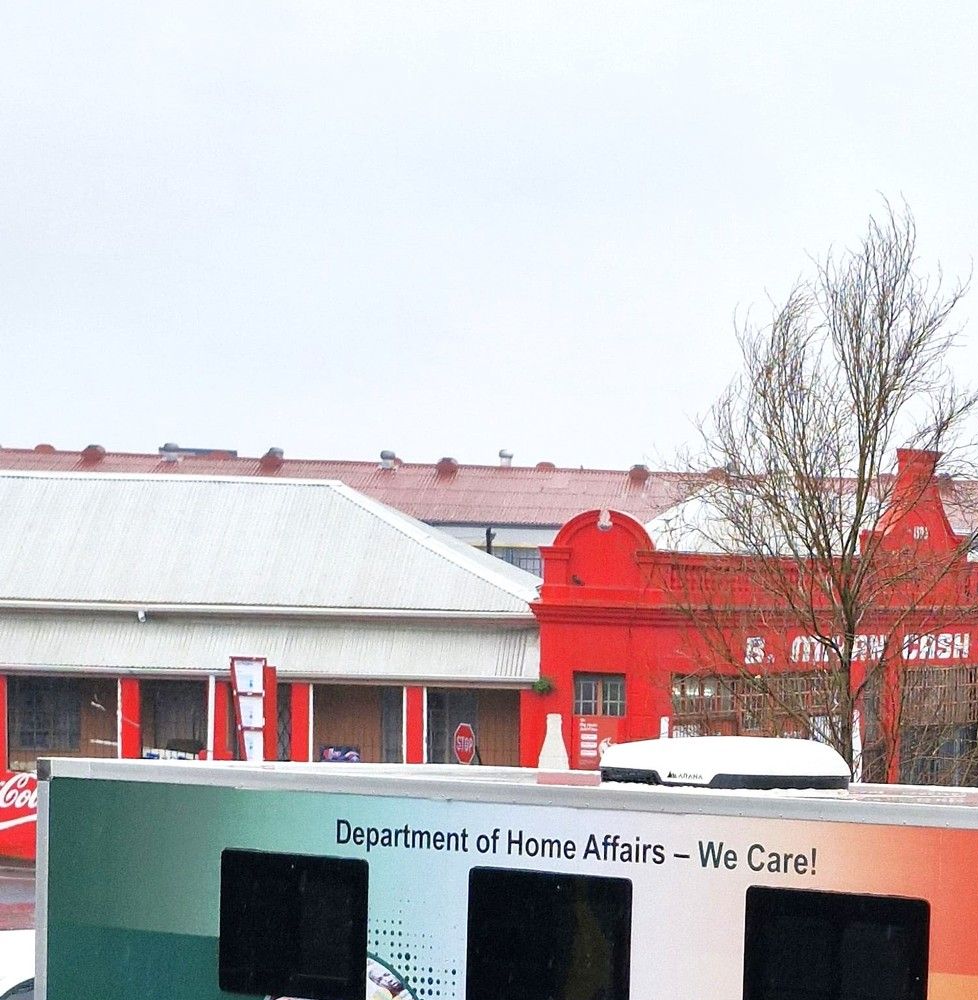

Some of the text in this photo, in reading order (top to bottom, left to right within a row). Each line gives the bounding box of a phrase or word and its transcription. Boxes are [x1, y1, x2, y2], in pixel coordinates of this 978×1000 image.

[902, 631, 969, 660] CASH
[457, 736, 473, 751] STOP
[336, 818, 469, 853] Department
[476, 828, 500, 854] of
[507, 829, 576, 860] Home
[583, 833, 666, 865] Affairs
[698, 840, 738, 869] We
[746, 843, 818, 875] Care!
